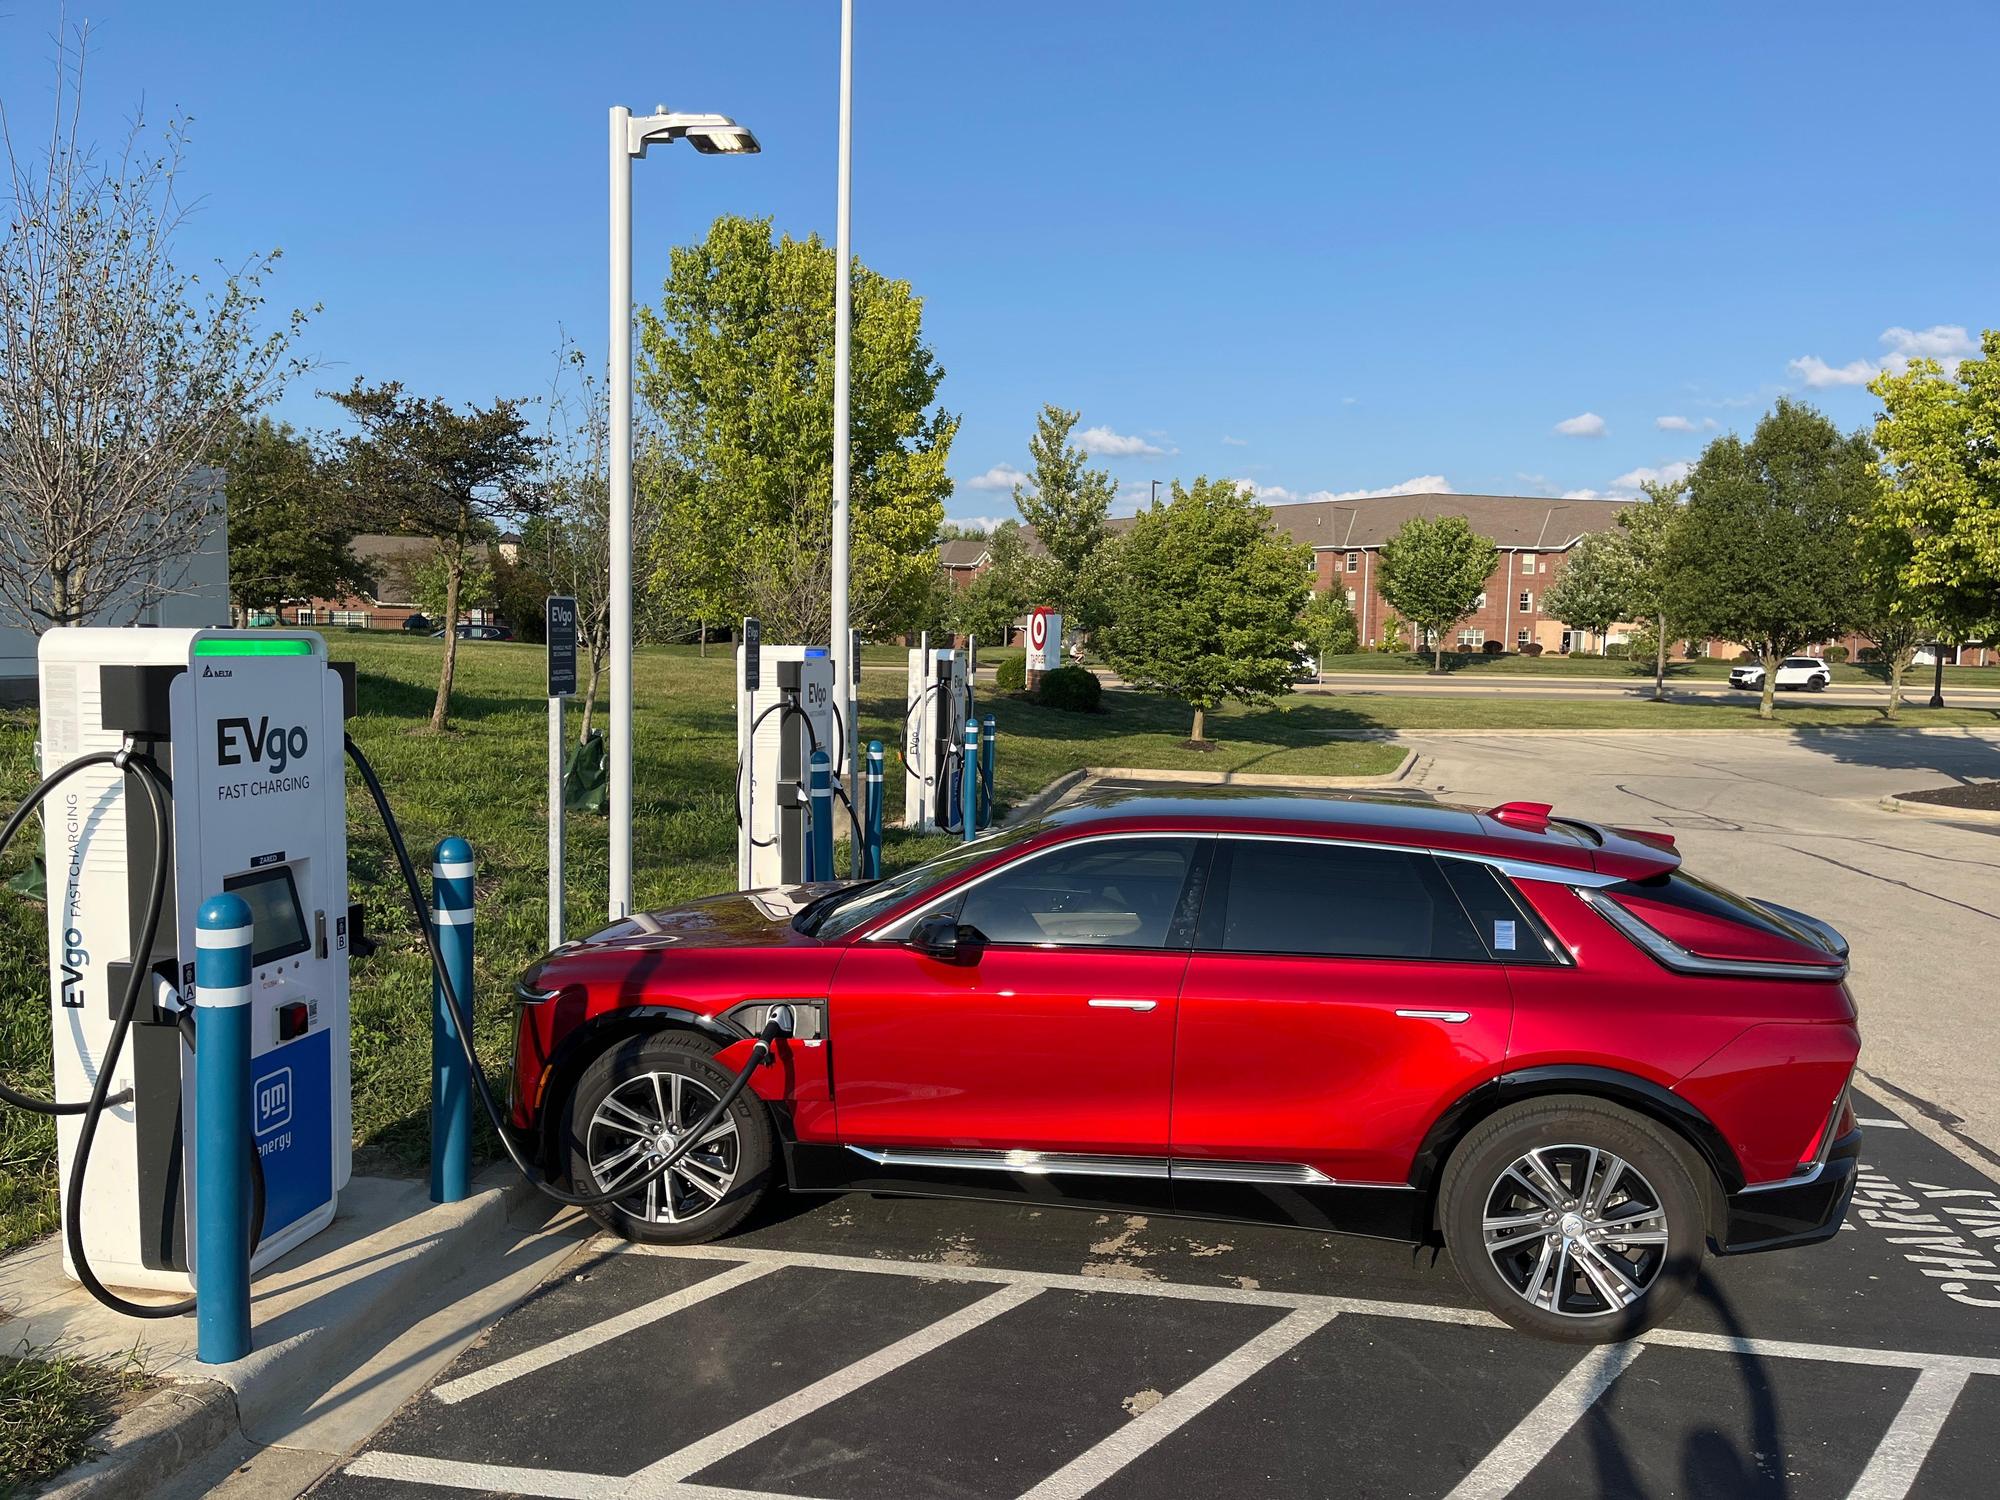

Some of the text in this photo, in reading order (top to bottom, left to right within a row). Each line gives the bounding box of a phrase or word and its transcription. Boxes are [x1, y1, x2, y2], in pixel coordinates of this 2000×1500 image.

[551, 606, 573, 627] EVgo
[1030, 654, 1047, 664] TARGET
[808, 683, 827, 708] EVgo
[216, 715, 308, 775] EVgo
[910, 731, 920, 755] EVgo
[218, 775, 310, 801] FAST CHARGING
[60, 794, 90, 1009] EVgo FAST CHARGING
[186, 984, 194, 999] A
[261, 1082, 286, 1120] gm
[704, 1065, 752, 1118] MICLIN
